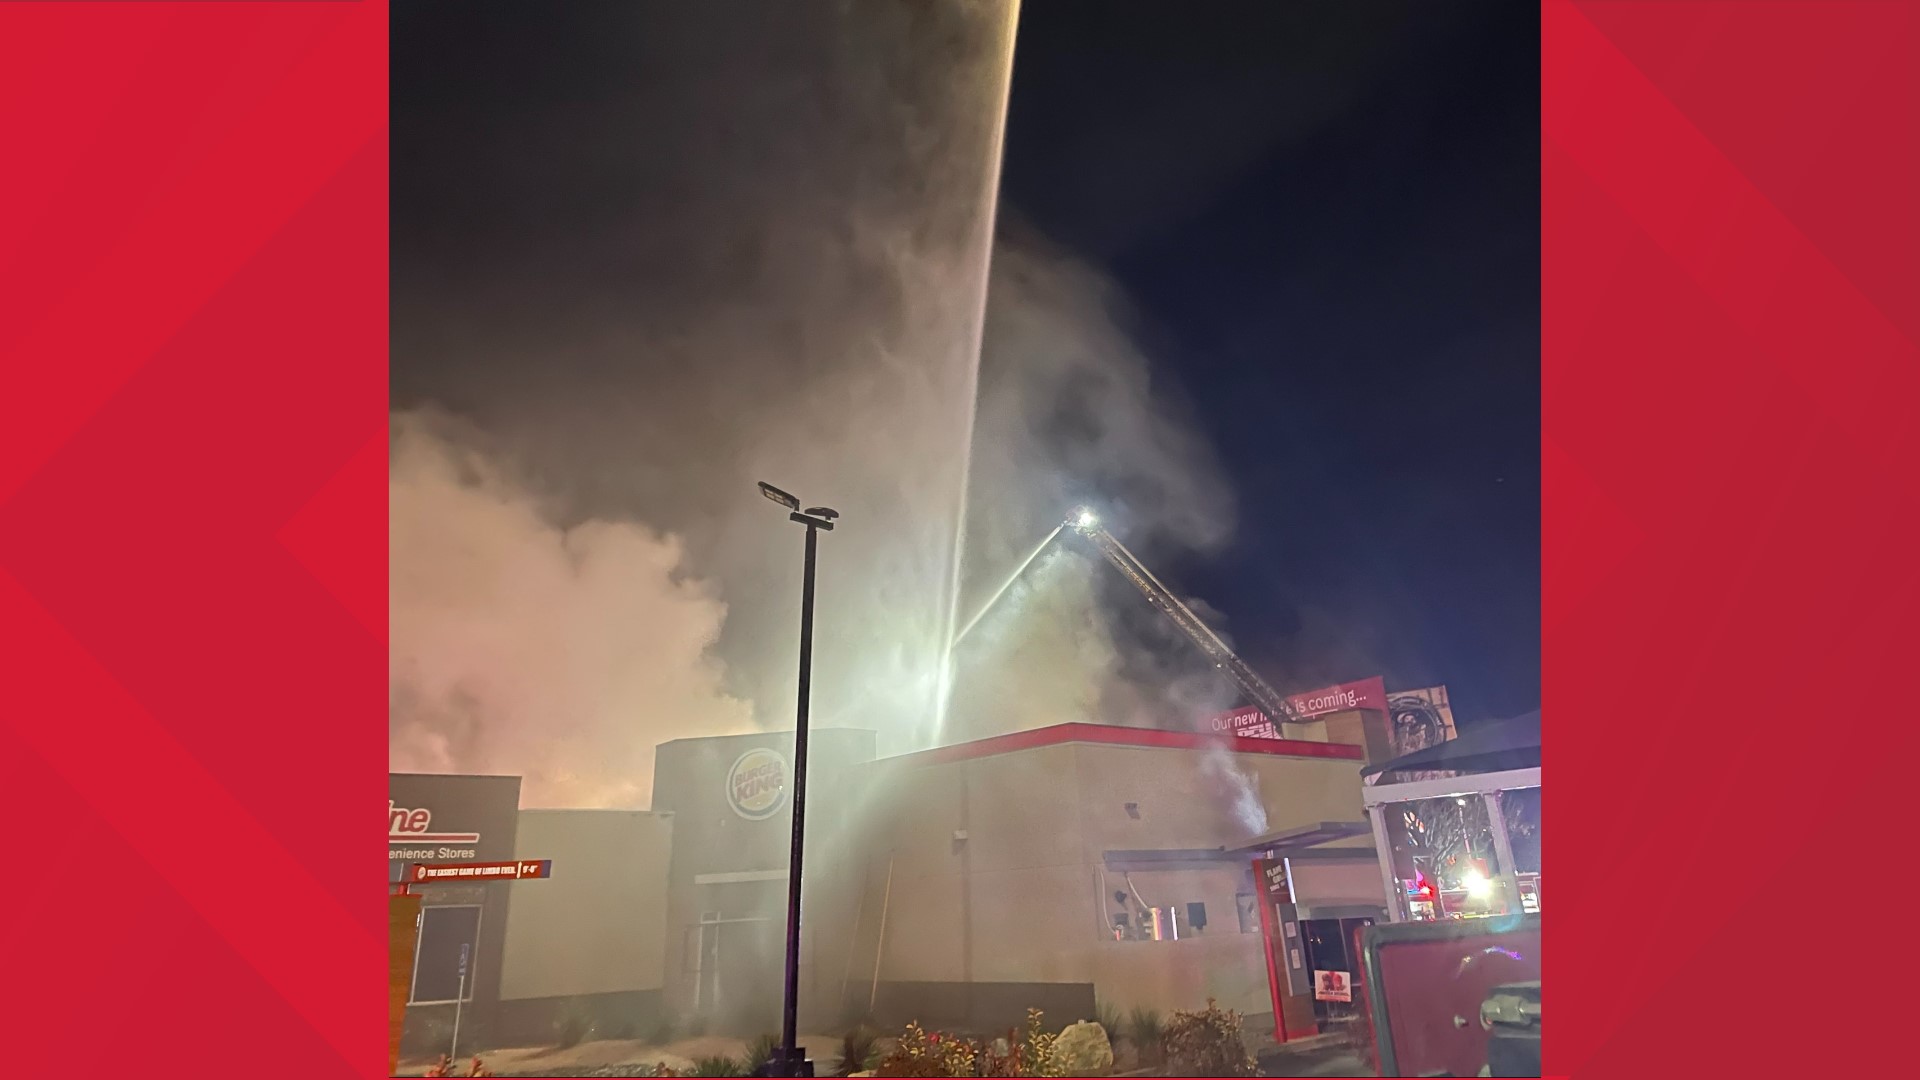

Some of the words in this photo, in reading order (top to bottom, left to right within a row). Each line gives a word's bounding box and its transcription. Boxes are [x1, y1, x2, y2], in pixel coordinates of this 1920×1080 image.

[1211, 716, 1233, 731] Our
[1234, 711, 1258, 727] new
[1294, 699, 1306, 713] is
[1308, 689, 1367, 711] coming...
[735, 760, 783, 786] BURGER
[736, 772, 784, 802] KING
[389, 800, 431, 834] ne
[438, 847, 475, 859] Stores
